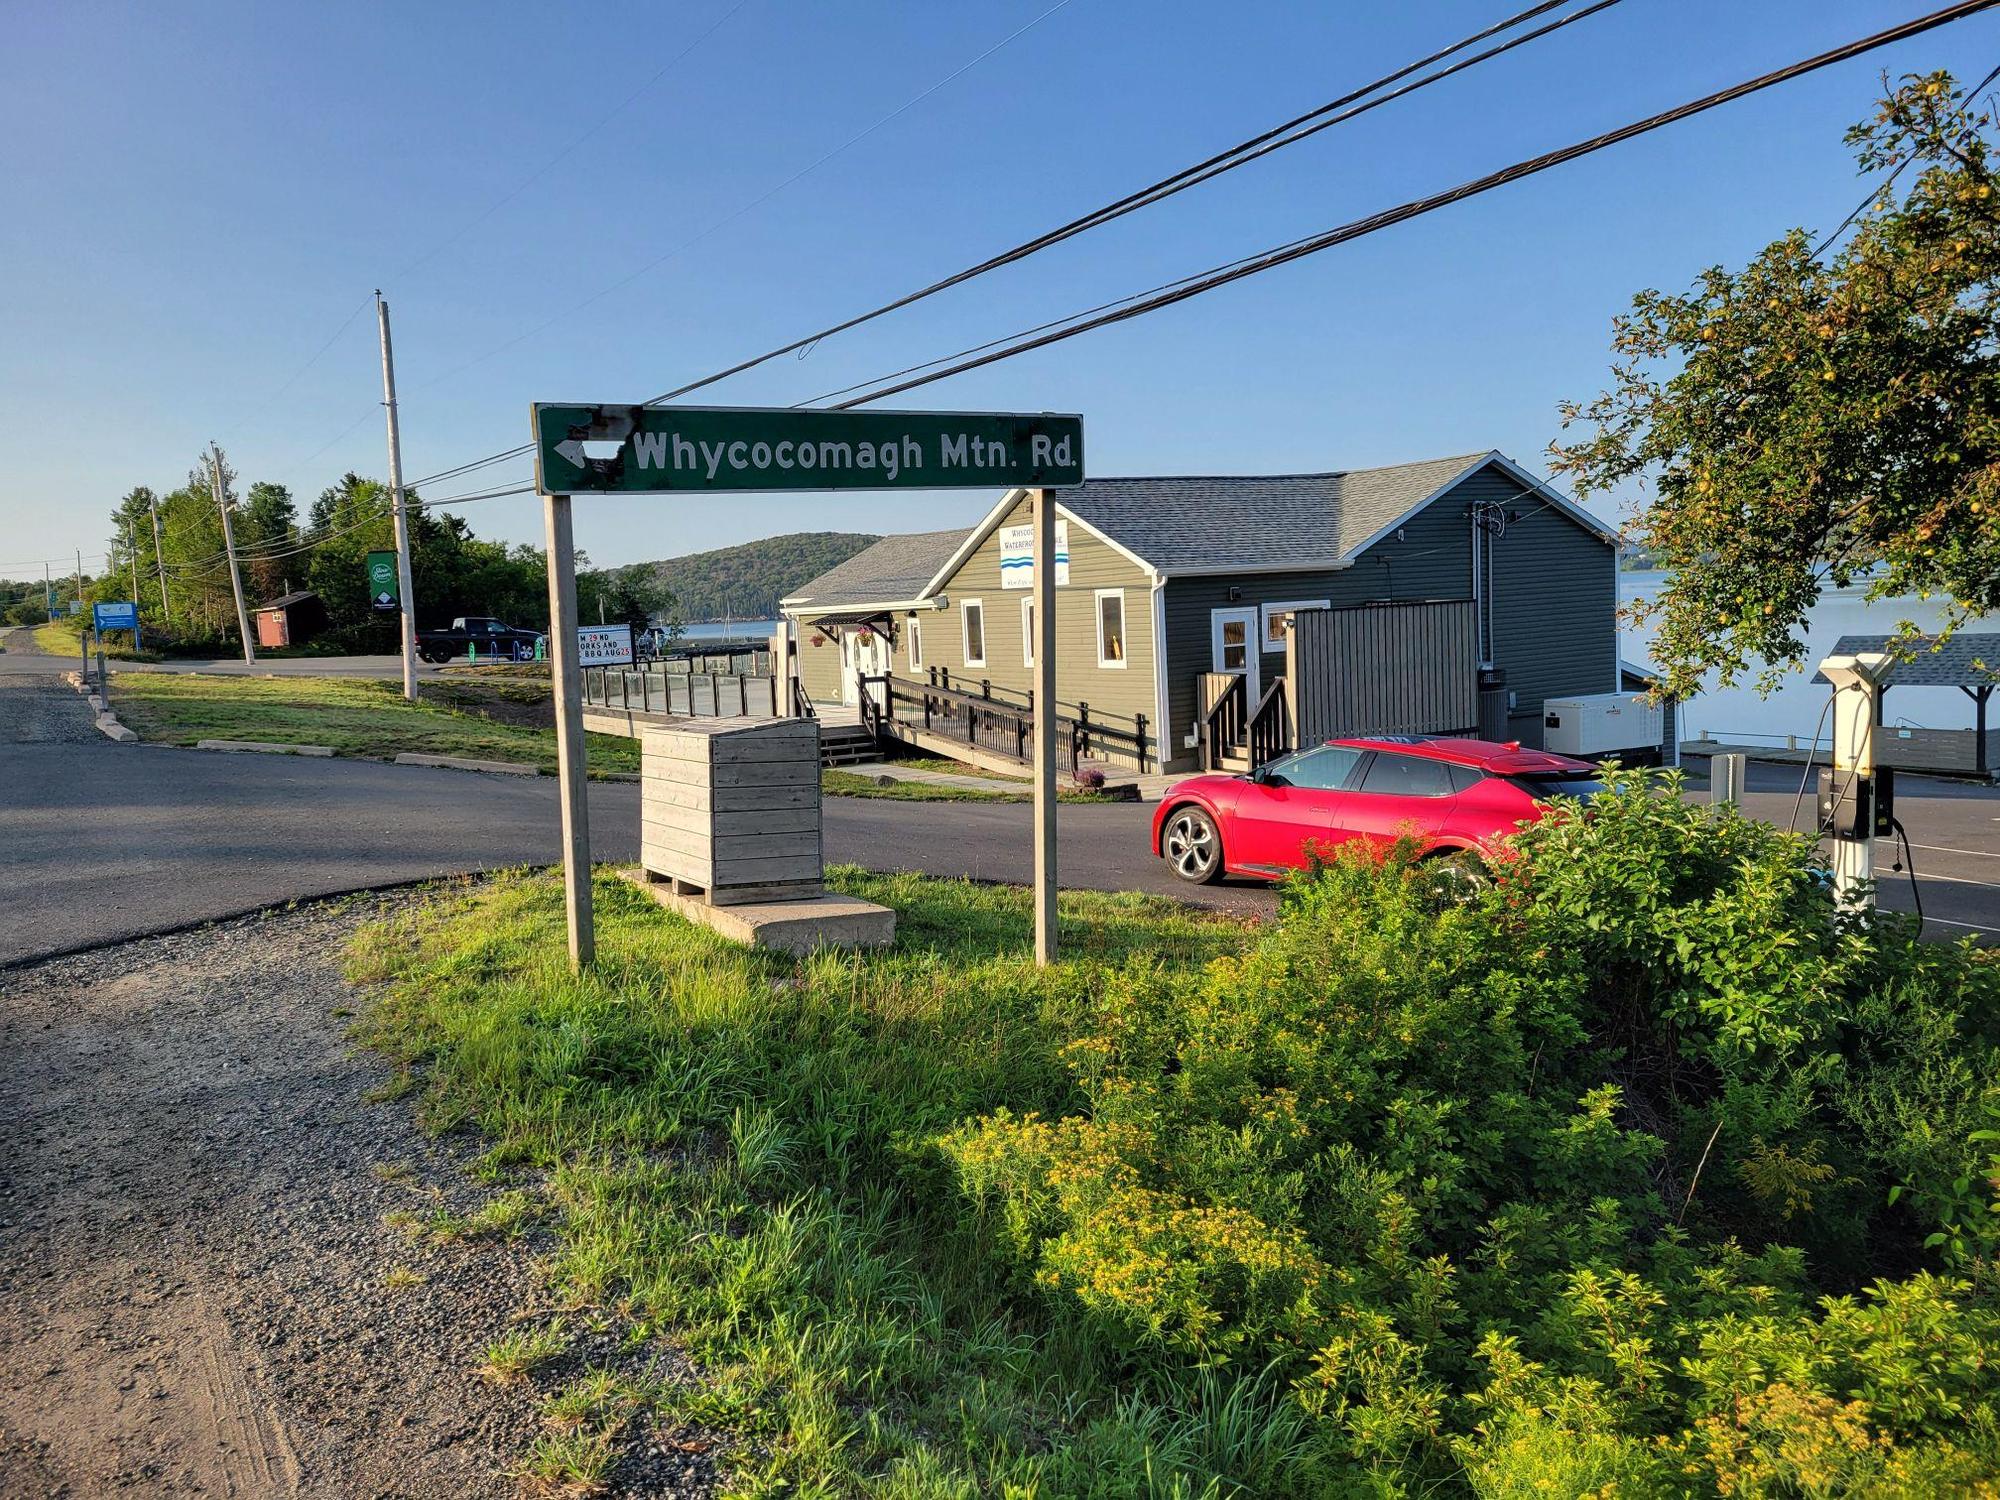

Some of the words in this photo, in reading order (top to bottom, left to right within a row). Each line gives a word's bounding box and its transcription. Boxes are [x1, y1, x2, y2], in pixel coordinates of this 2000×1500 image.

[633, 432, 923, 480] Whycocomagh
[941, 433, 1017, 468] Mtn.
[1031, 434, 1077, 467] Rd.
[1004, 540, 1034, 549] WATERFRO
